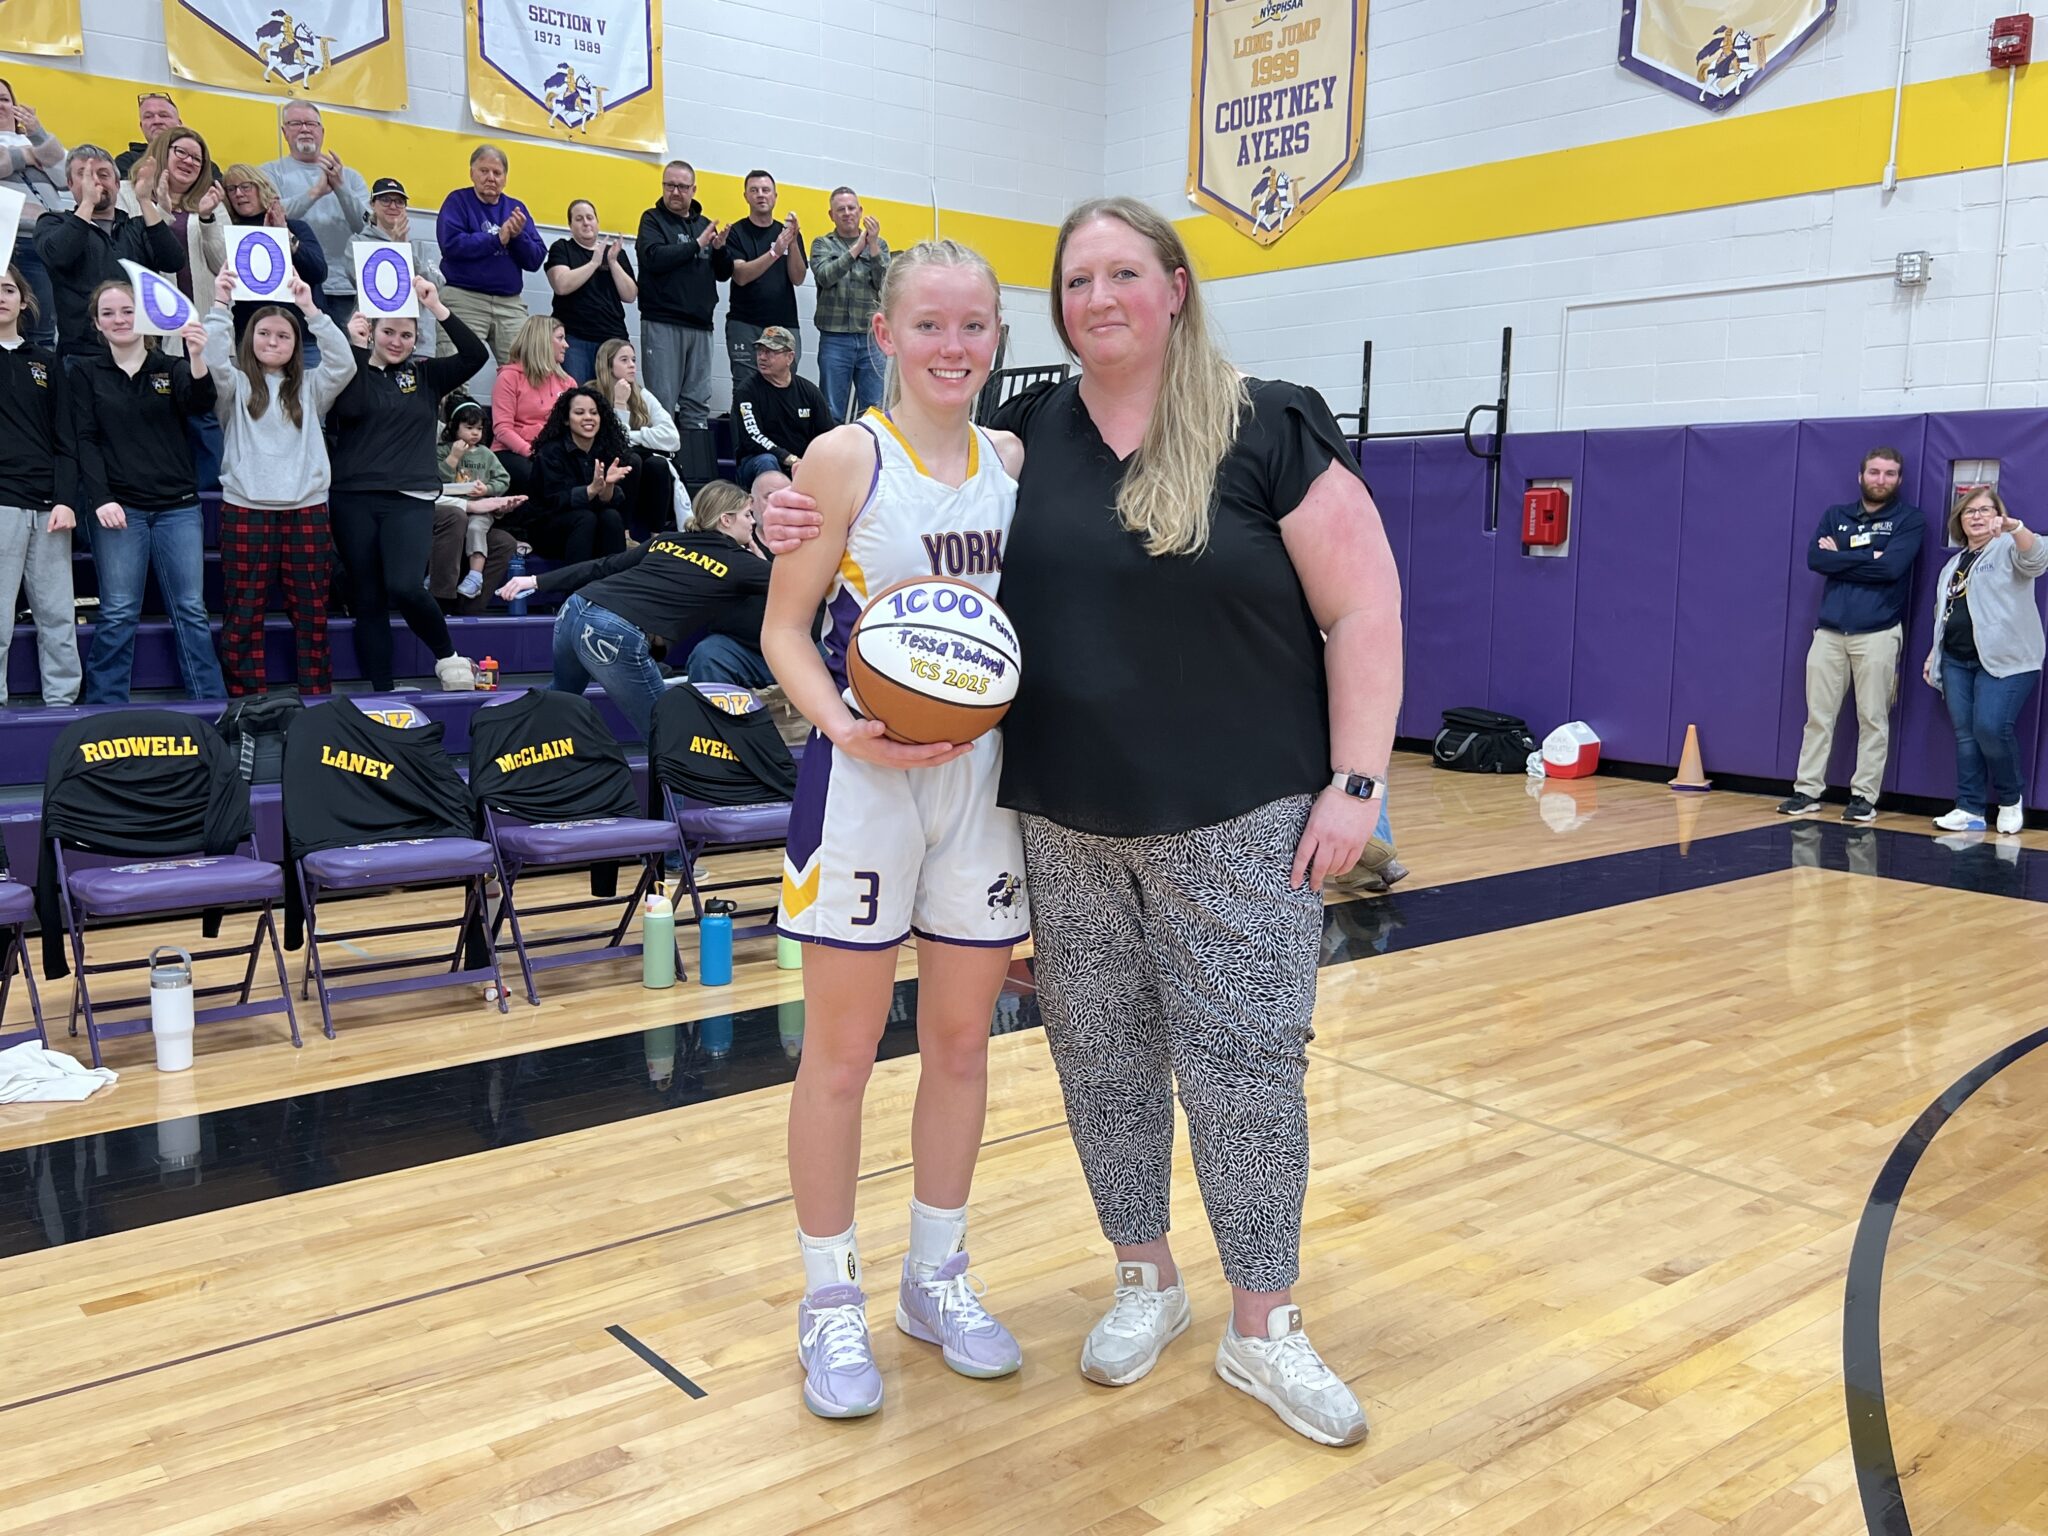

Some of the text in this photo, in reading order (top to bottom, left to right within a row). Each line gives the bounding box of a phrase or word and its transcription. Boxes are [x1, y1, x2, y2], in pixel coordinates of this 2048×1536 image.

[528, 4, 607, 36] SECTION V
[1233, 17, 1321, 59] LONG JUMP
[534, 30, 601, 54] 1973 1989
[1251, 49, 1299, 88] 1999
[1215, 75, 1338, 134] COURTNEY
[1236, 120, 1310, 167] AYERS
[740, 402, 777, 450] CATERPLAR
[798, 408, 811, 418] CAT
[921, 529, 1003, 576] YORK
[898, 629, 1005, 679] Tessa Rodwell
[910, 657, 991, 694] YCS 2025
[80, 736, 199, 763] RODWELL
[321, 745, 395, 781] LANEY
[495, 737, 575, 773] McCLAIN
[851, 871, 880, 926] 3
